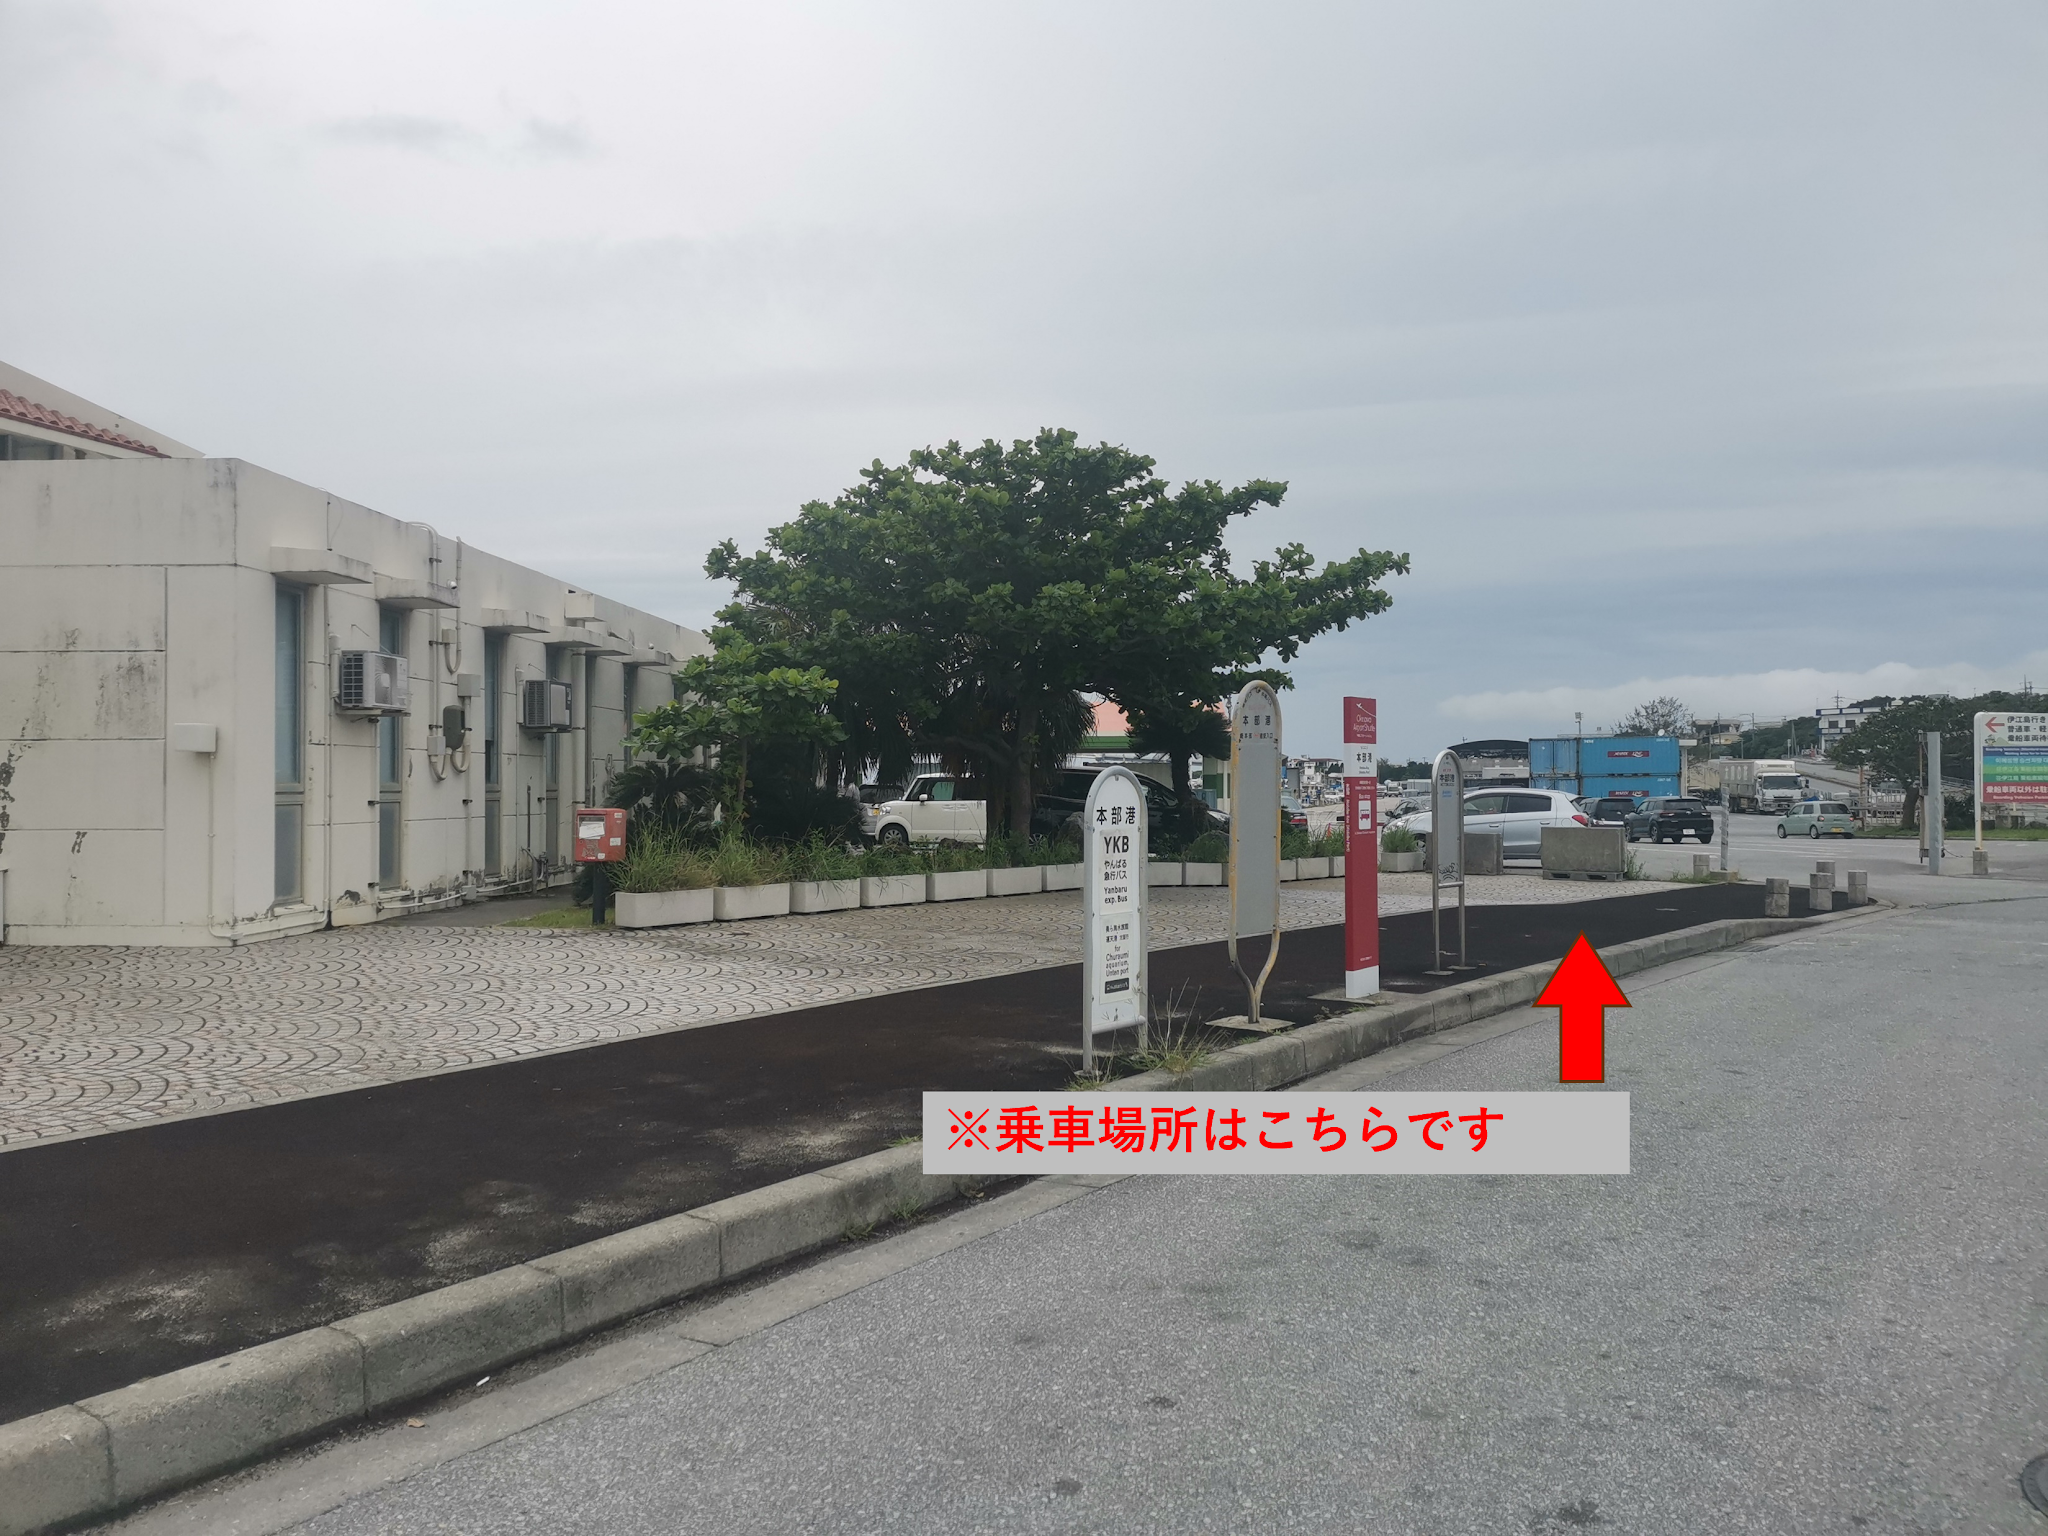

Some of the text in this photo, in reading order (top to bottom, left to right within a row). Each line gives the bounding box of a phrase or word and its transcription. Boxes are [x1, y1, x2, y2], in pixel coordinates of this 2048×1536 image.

[2007, 715, 2046, 723] 伊江島行き
[2007, 734, 2048, 742] 乗船車両待
[1096, 806, 1136, 825] 本部港
[1104, 835, 1129, 854] YKB
[1104, 859, 1128, 869] やんばる
[1104, 870, 1128, 881] 急行バス
[1104, 885, 1128, 895] Yanbaru
[1104, 894, 1128, 904] exp. Bus
[1105, 950, 1129, 962] Churaumi
